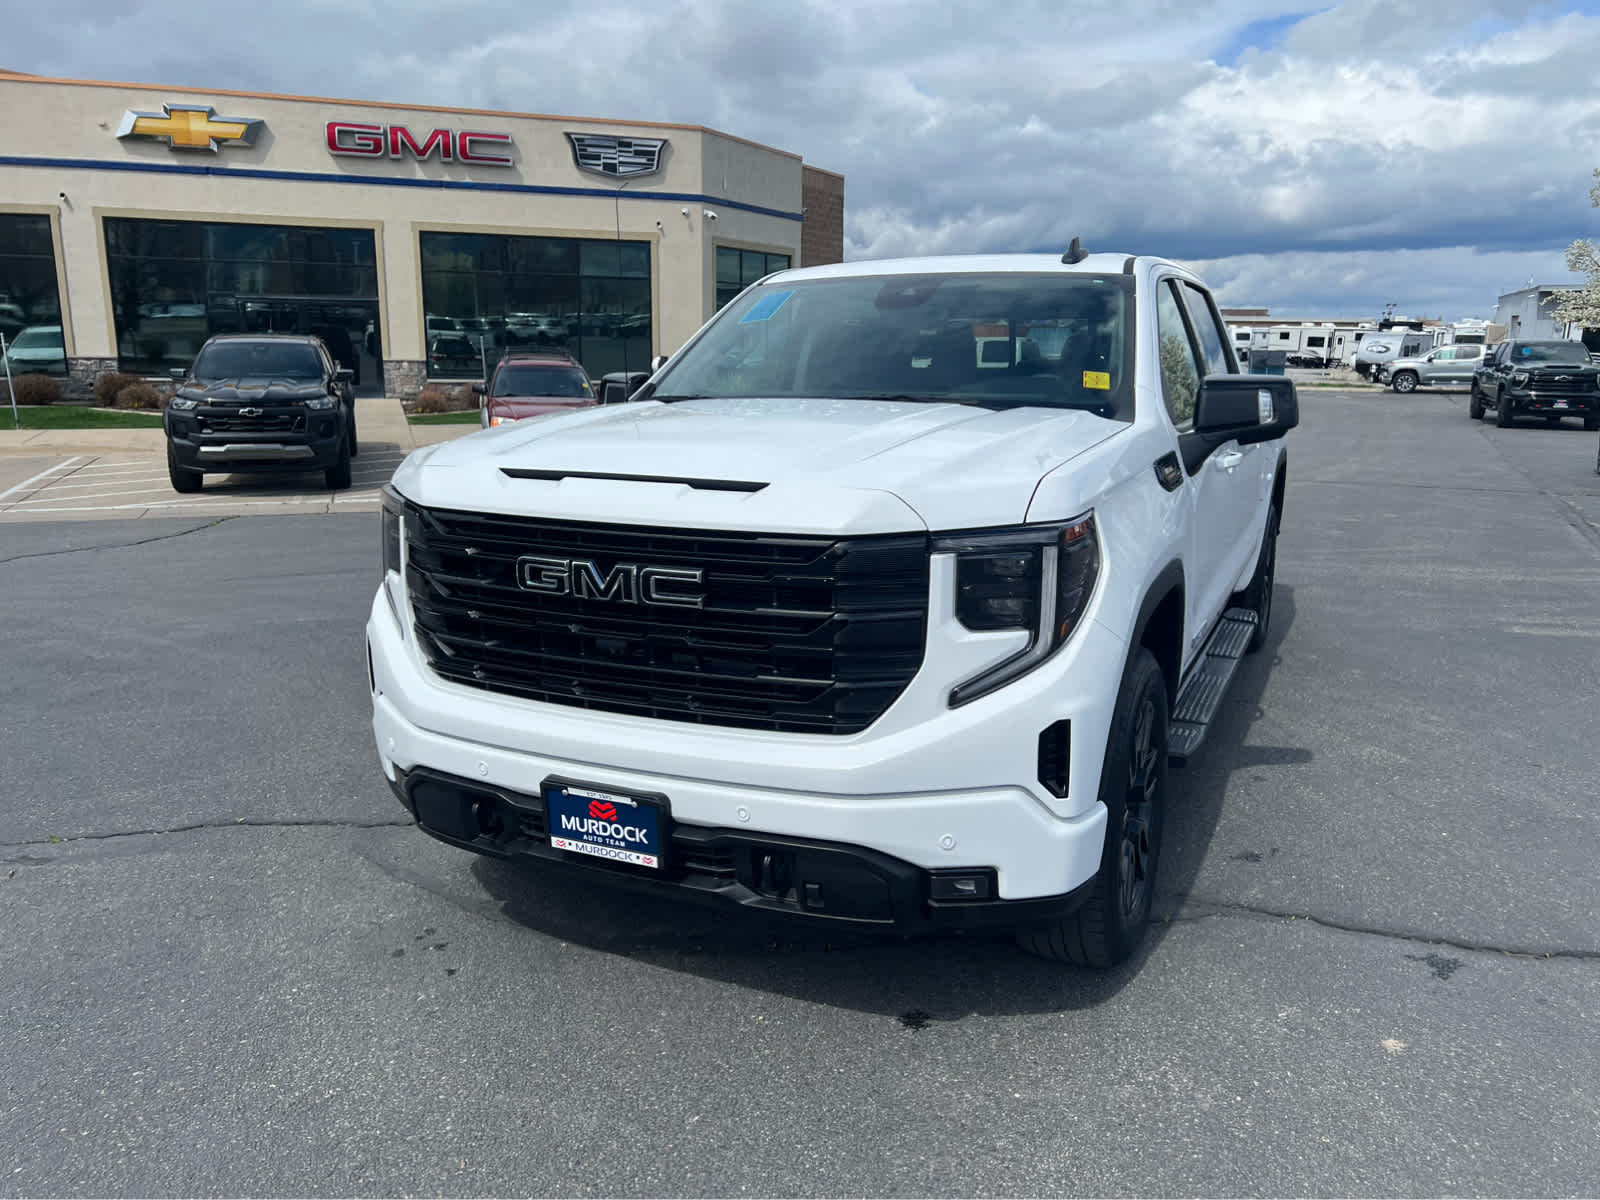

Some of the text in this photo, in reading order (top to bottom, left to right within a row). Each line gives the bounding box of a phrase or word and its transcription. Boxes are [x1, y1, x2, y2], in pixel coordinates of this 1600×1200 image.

[325, 121, 513, 167] GMC
[516, 556, 703, 609] GMC
[561, 814, 648, 844] MURDOCK
[583, 834, 626, 847] AUTO TEAM
[575, 842, 633, 861] MURDOCK
